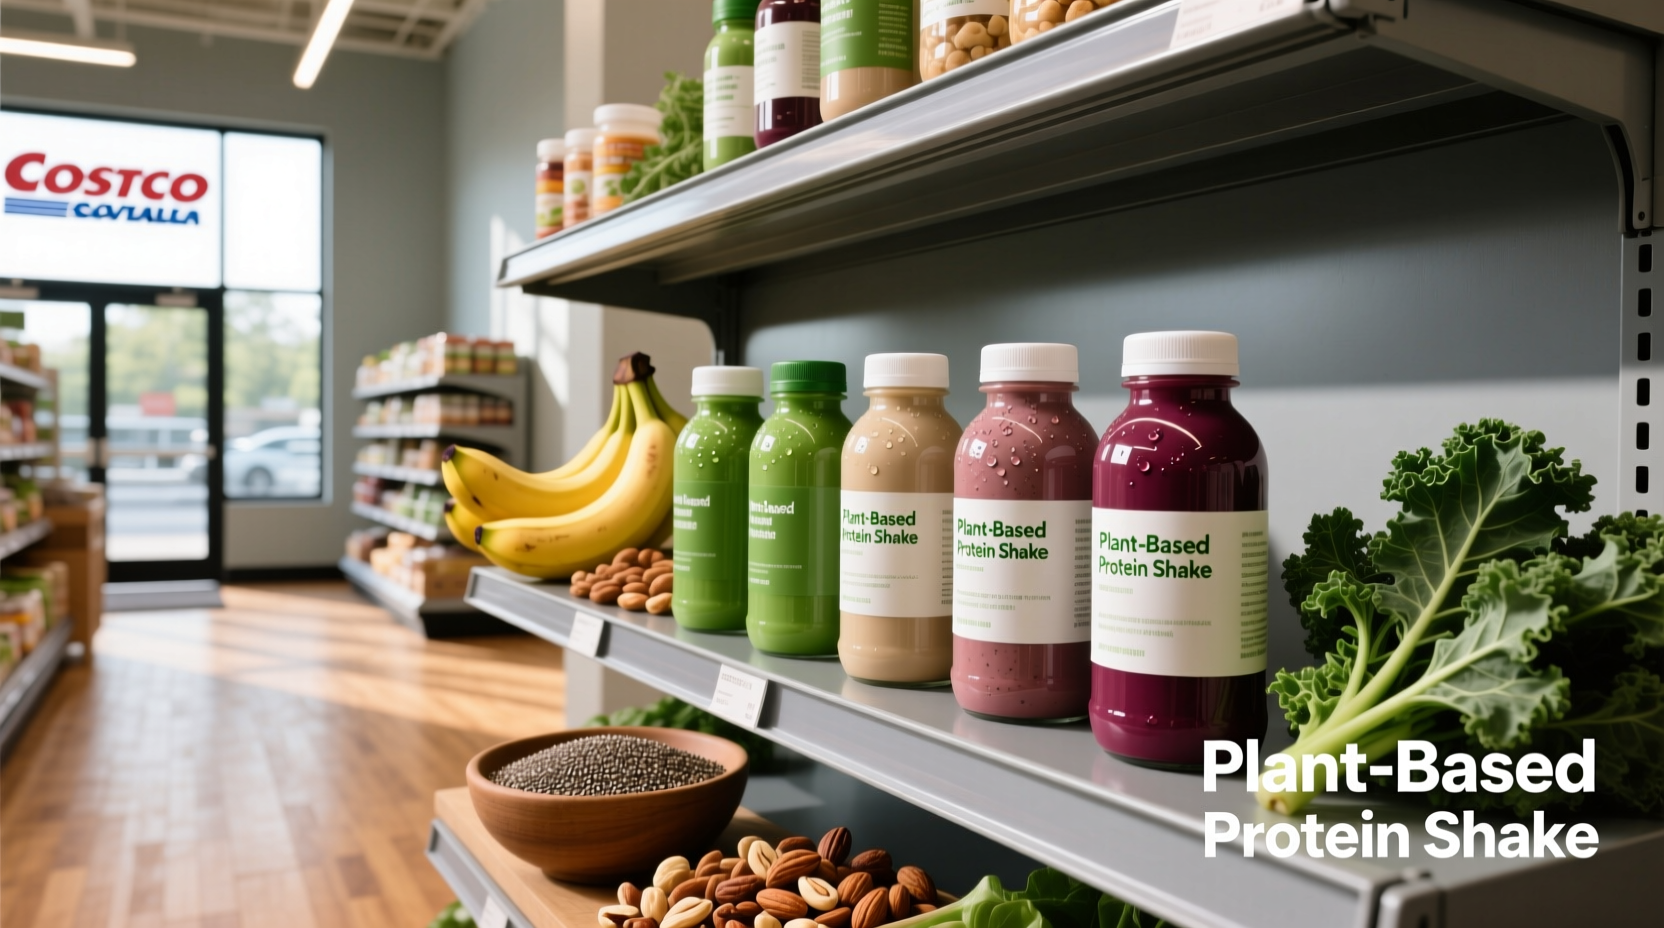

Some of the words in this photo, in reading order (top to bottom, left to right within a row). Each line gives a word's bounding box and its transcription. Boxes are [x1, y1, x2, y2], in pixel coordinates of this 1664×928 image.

[4, 152, 209, 203] COSTCO
[842, 508, 916, 526] Plant-Based
[874, 528, 919, 545] Shake
[957, 518, 1047, 538] Plant-Based
[957, 539, 996, 559] Protein
[998, 542, 1049, 560] Shake
[1099, 531, 1210, 555] Plant-Based
[1098, 555, 1148, 578] Protein
[1153, 559, 1213, 579] Shake
